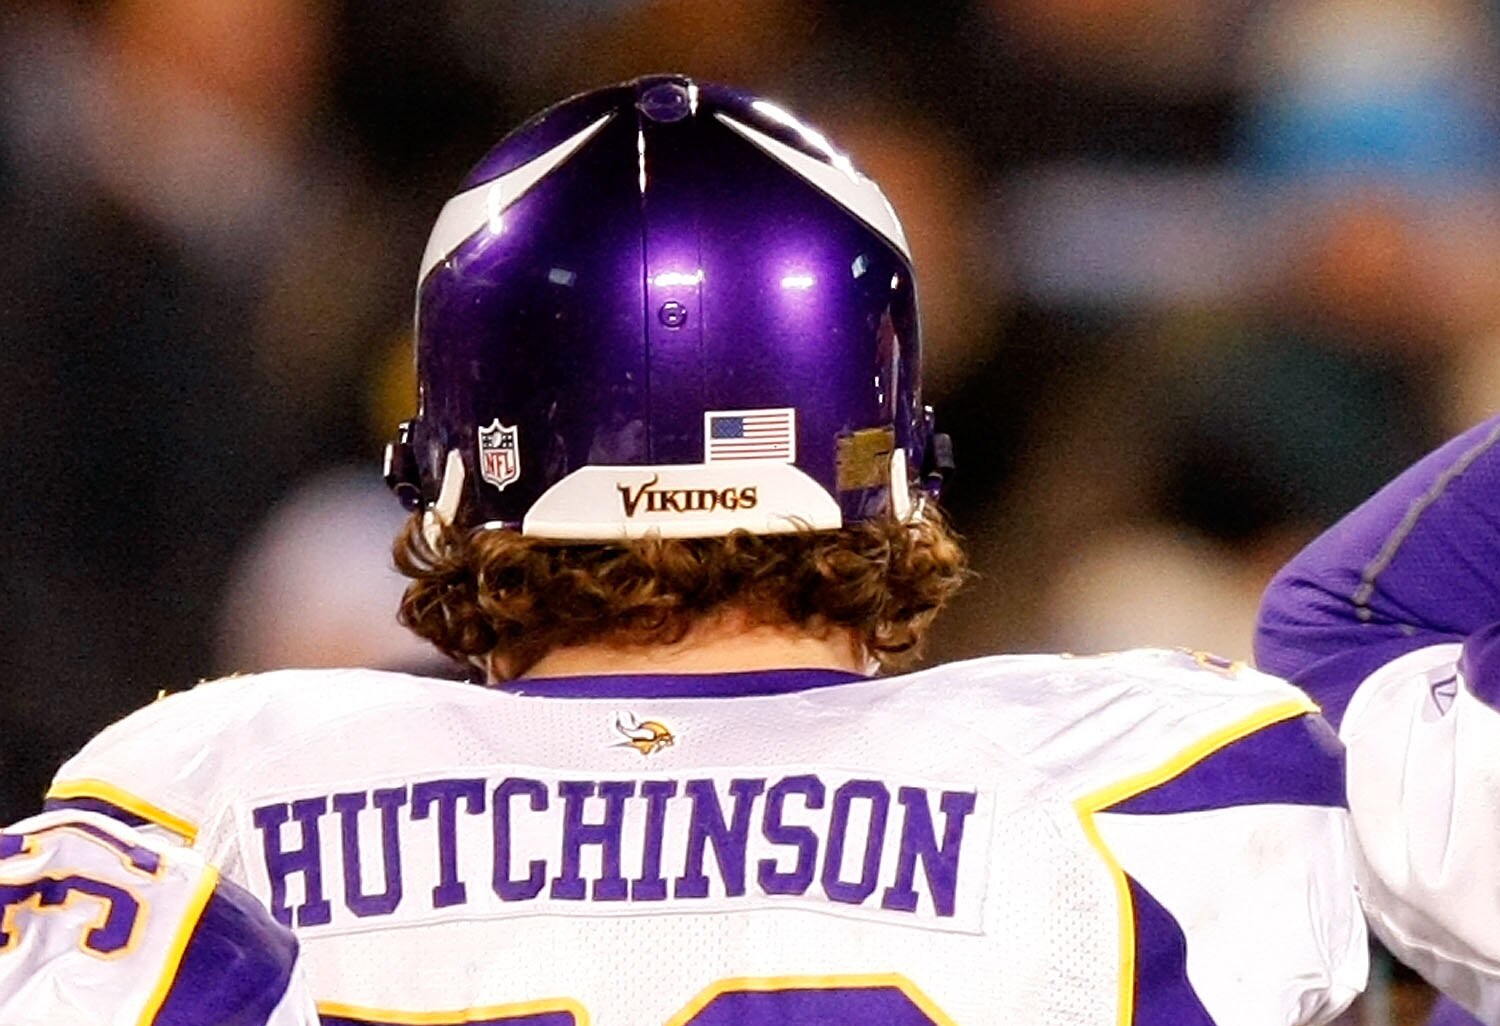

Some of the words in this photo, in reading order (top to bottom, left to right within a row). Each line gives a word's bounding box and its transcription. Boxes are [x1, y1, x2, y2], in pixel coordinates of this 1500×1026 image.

[484, 451, 514, 480] NFL
[616, 473, 758, 518] VIKINGS
[252, 773, 977, 930] HUTCHINSON
